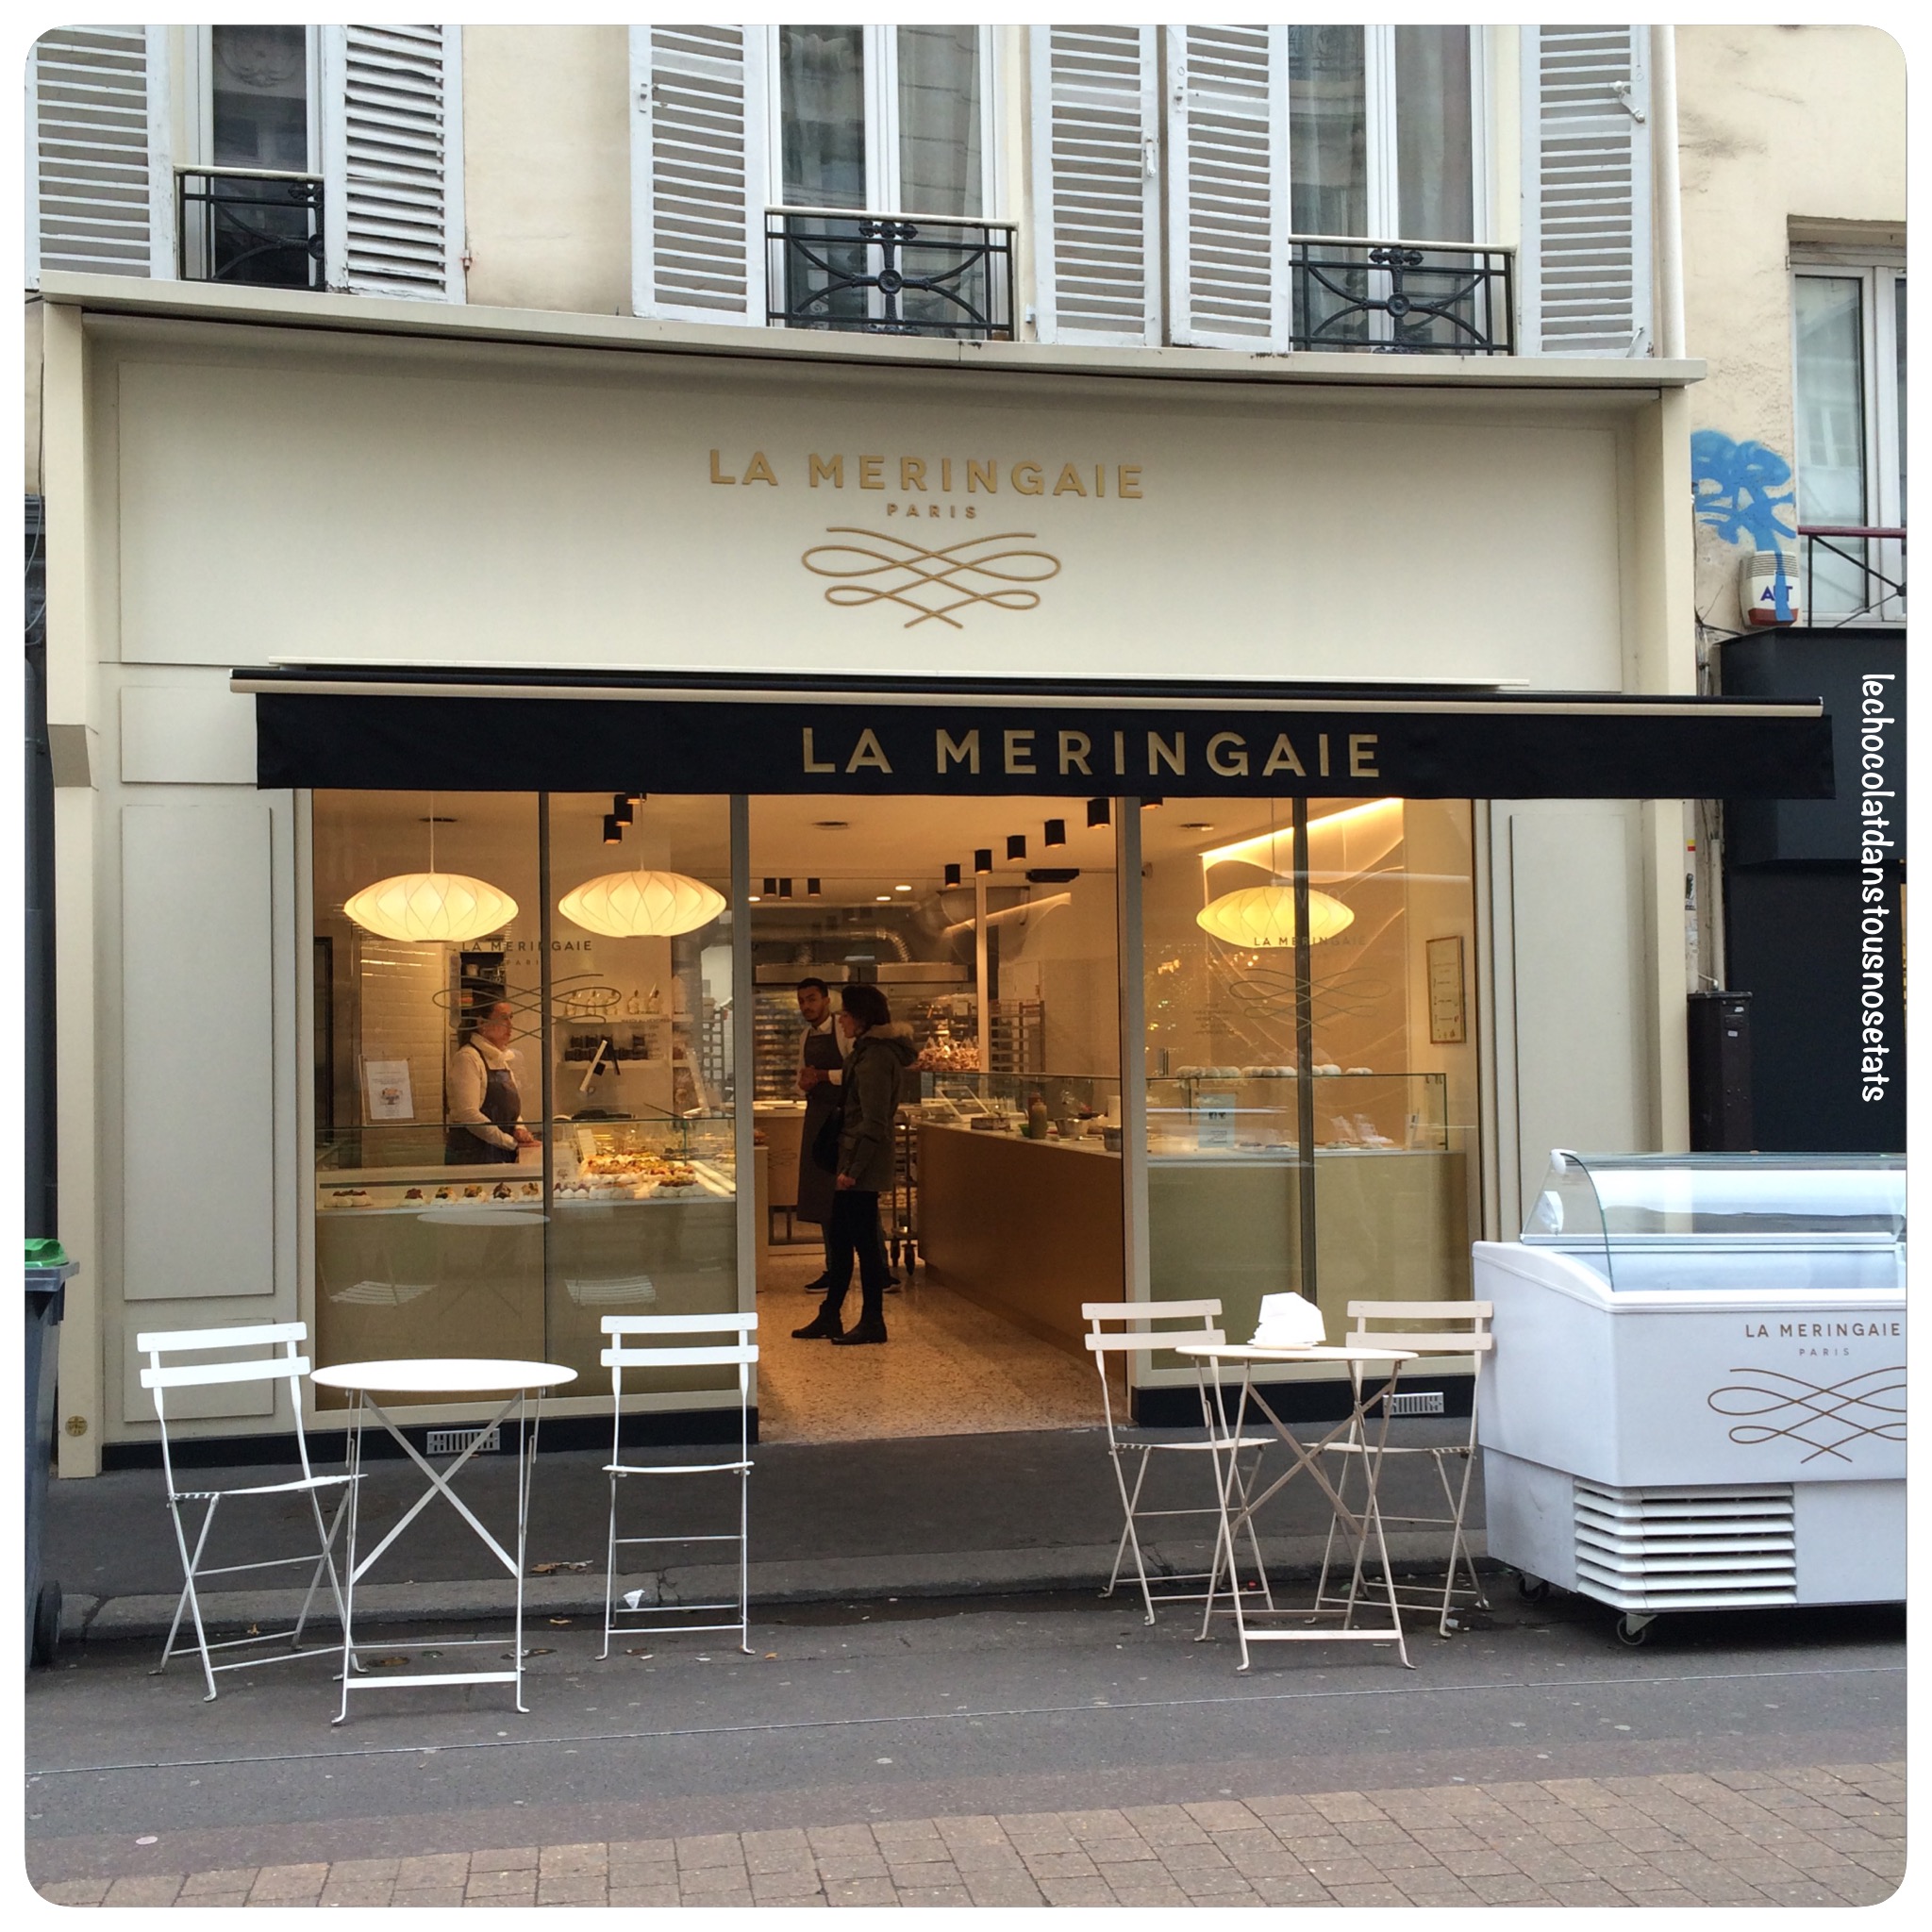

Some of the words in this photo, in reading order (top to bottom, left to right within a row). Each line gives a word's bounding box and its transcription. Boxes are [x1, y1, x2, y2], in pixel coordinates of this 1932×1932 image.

[709, 449, 778, 486] LA
[808, 453, 1143, 498] MERINGAIE
[887, 503, 977, 518] PARIS
[1760, 585, 1793, 602] AT
[802, 726, 893, 774] LA
[936, 728, 1380, 778] MERINGAIE
[462, 942, 482, 951] LA
[491, 941, 592, 951] MERIGAIE
[1254, 937, 1272, 946] LA
[1745, 1324, 1770, 1338] LA
[1779, 1323, 1901, 1338] MERINGAIE
[1799, 1347, 1850, 1357] PARIS
